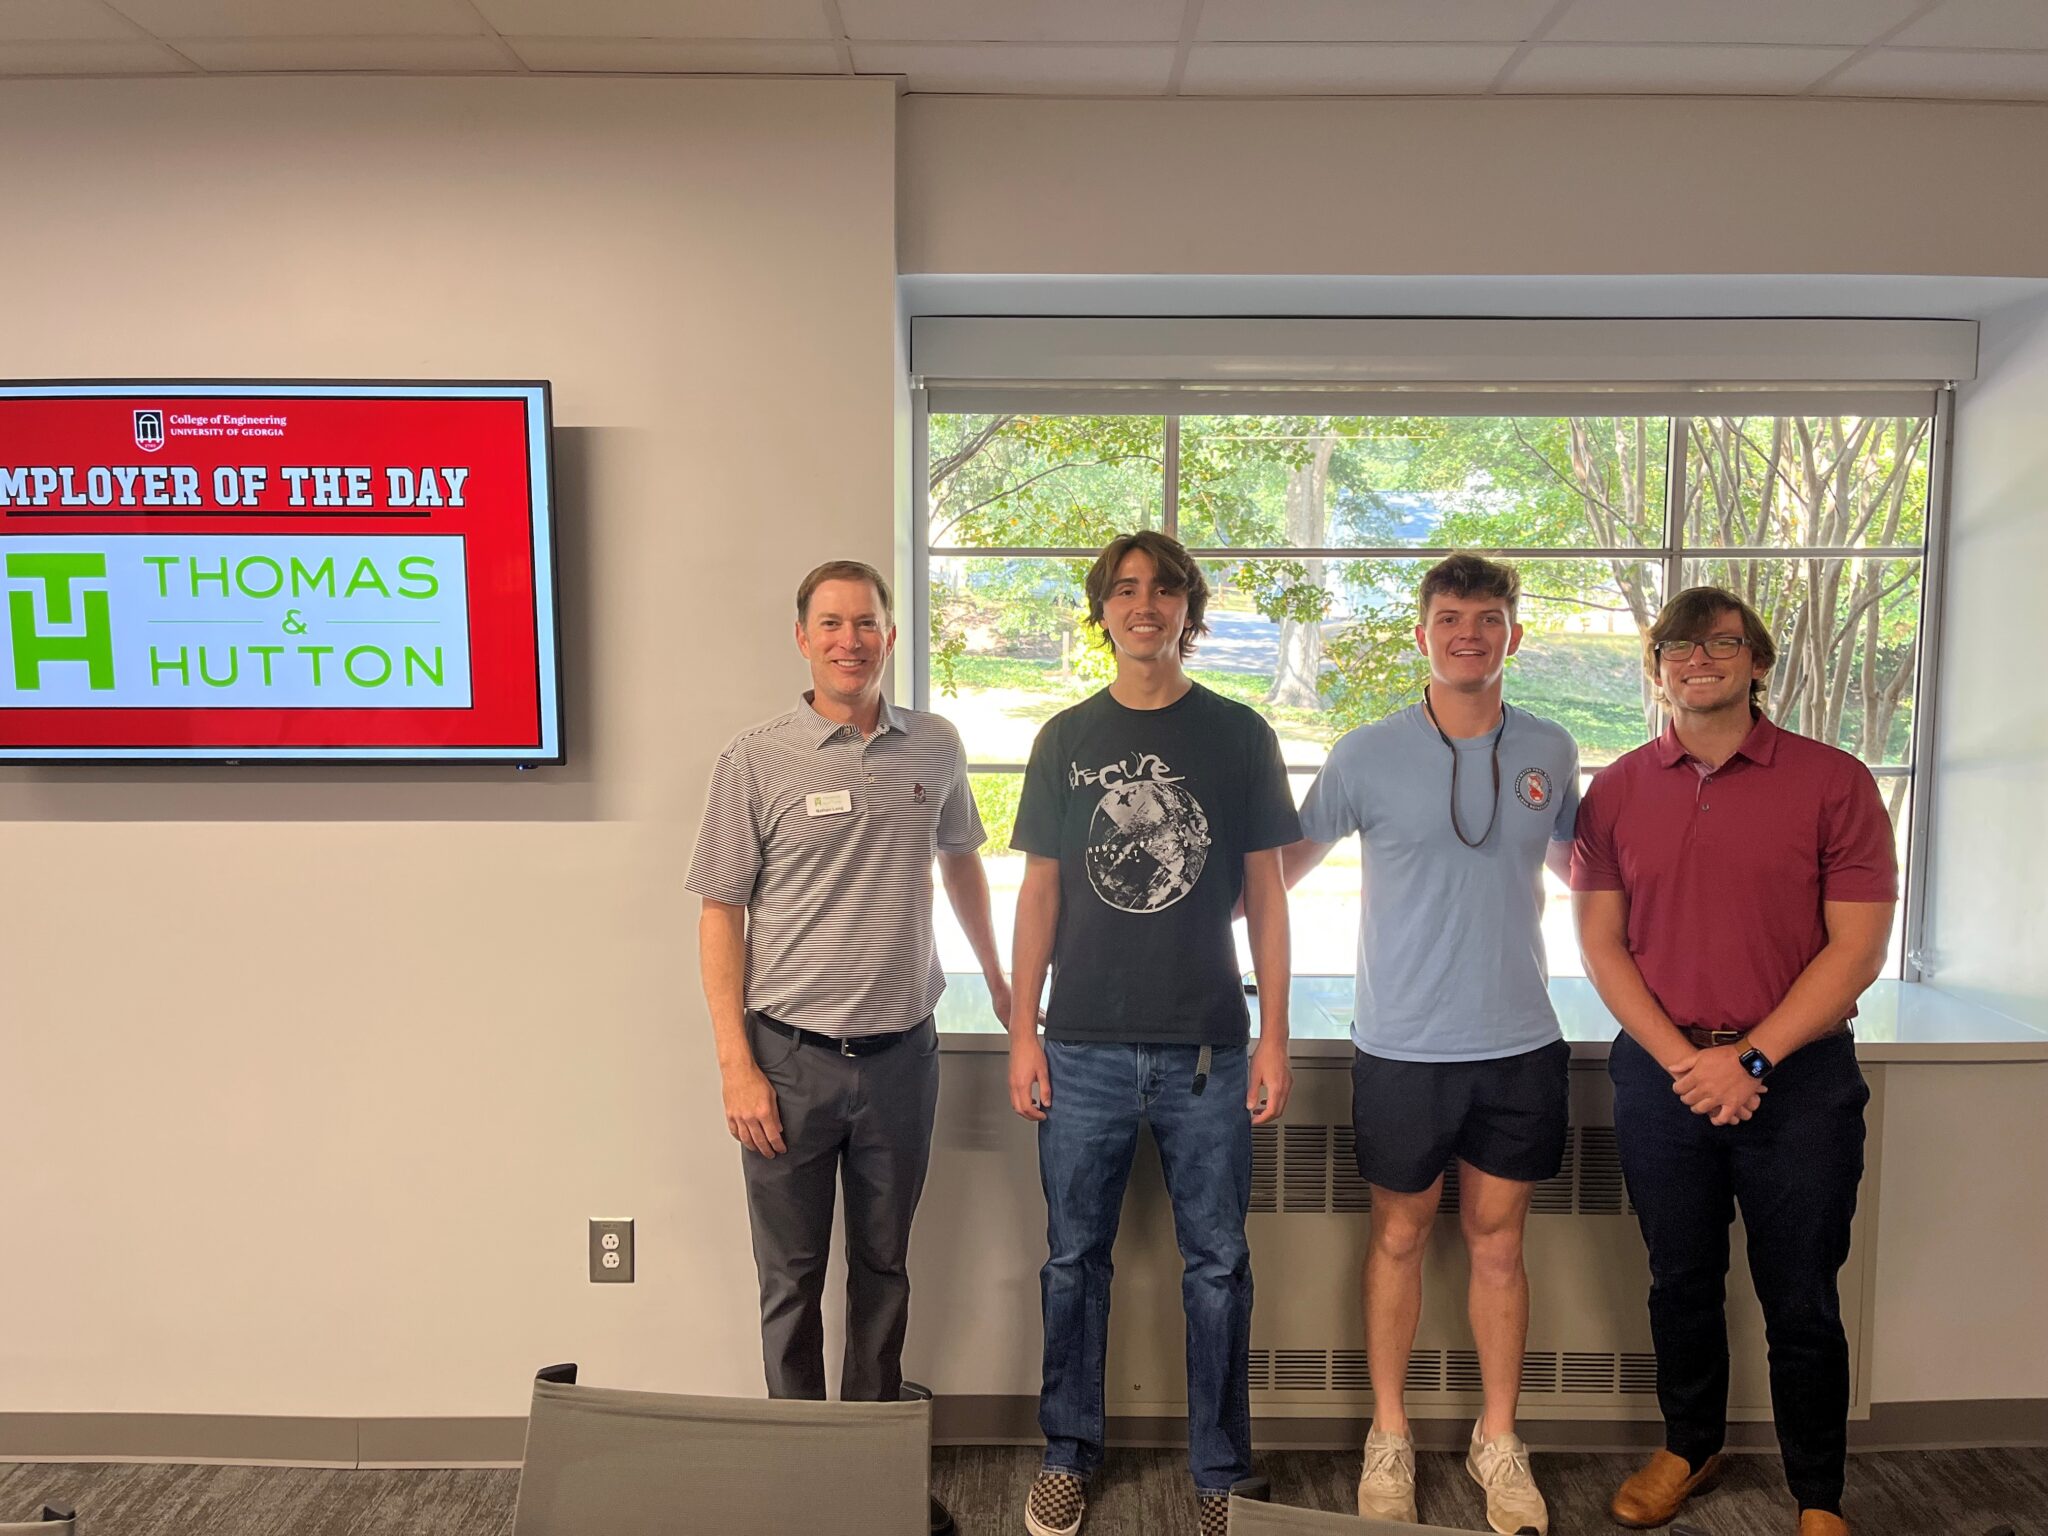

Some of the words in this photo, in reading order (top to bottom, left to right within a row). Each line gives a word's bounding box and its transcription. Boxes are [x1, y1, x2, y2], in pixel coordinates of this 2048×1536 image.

[170, 415, 208, 426] College
[210, 414, 221, 425] of
[223, 414, 287, 427] Engineering
[170, 428, 224, 436] UNIVERSITY
[226, 428, 239, 436] OF
[241, 428, 284, 436] GEORGIA
[213, 466, 268, 506] OF
[280, 466, 374, 507] THE
[385, 467, 469, 507] DAY
[143, 555, 439, 599] THOMAS
[281, 609, 308, 635] &
[150, 645, 444, 687] HUTTON
